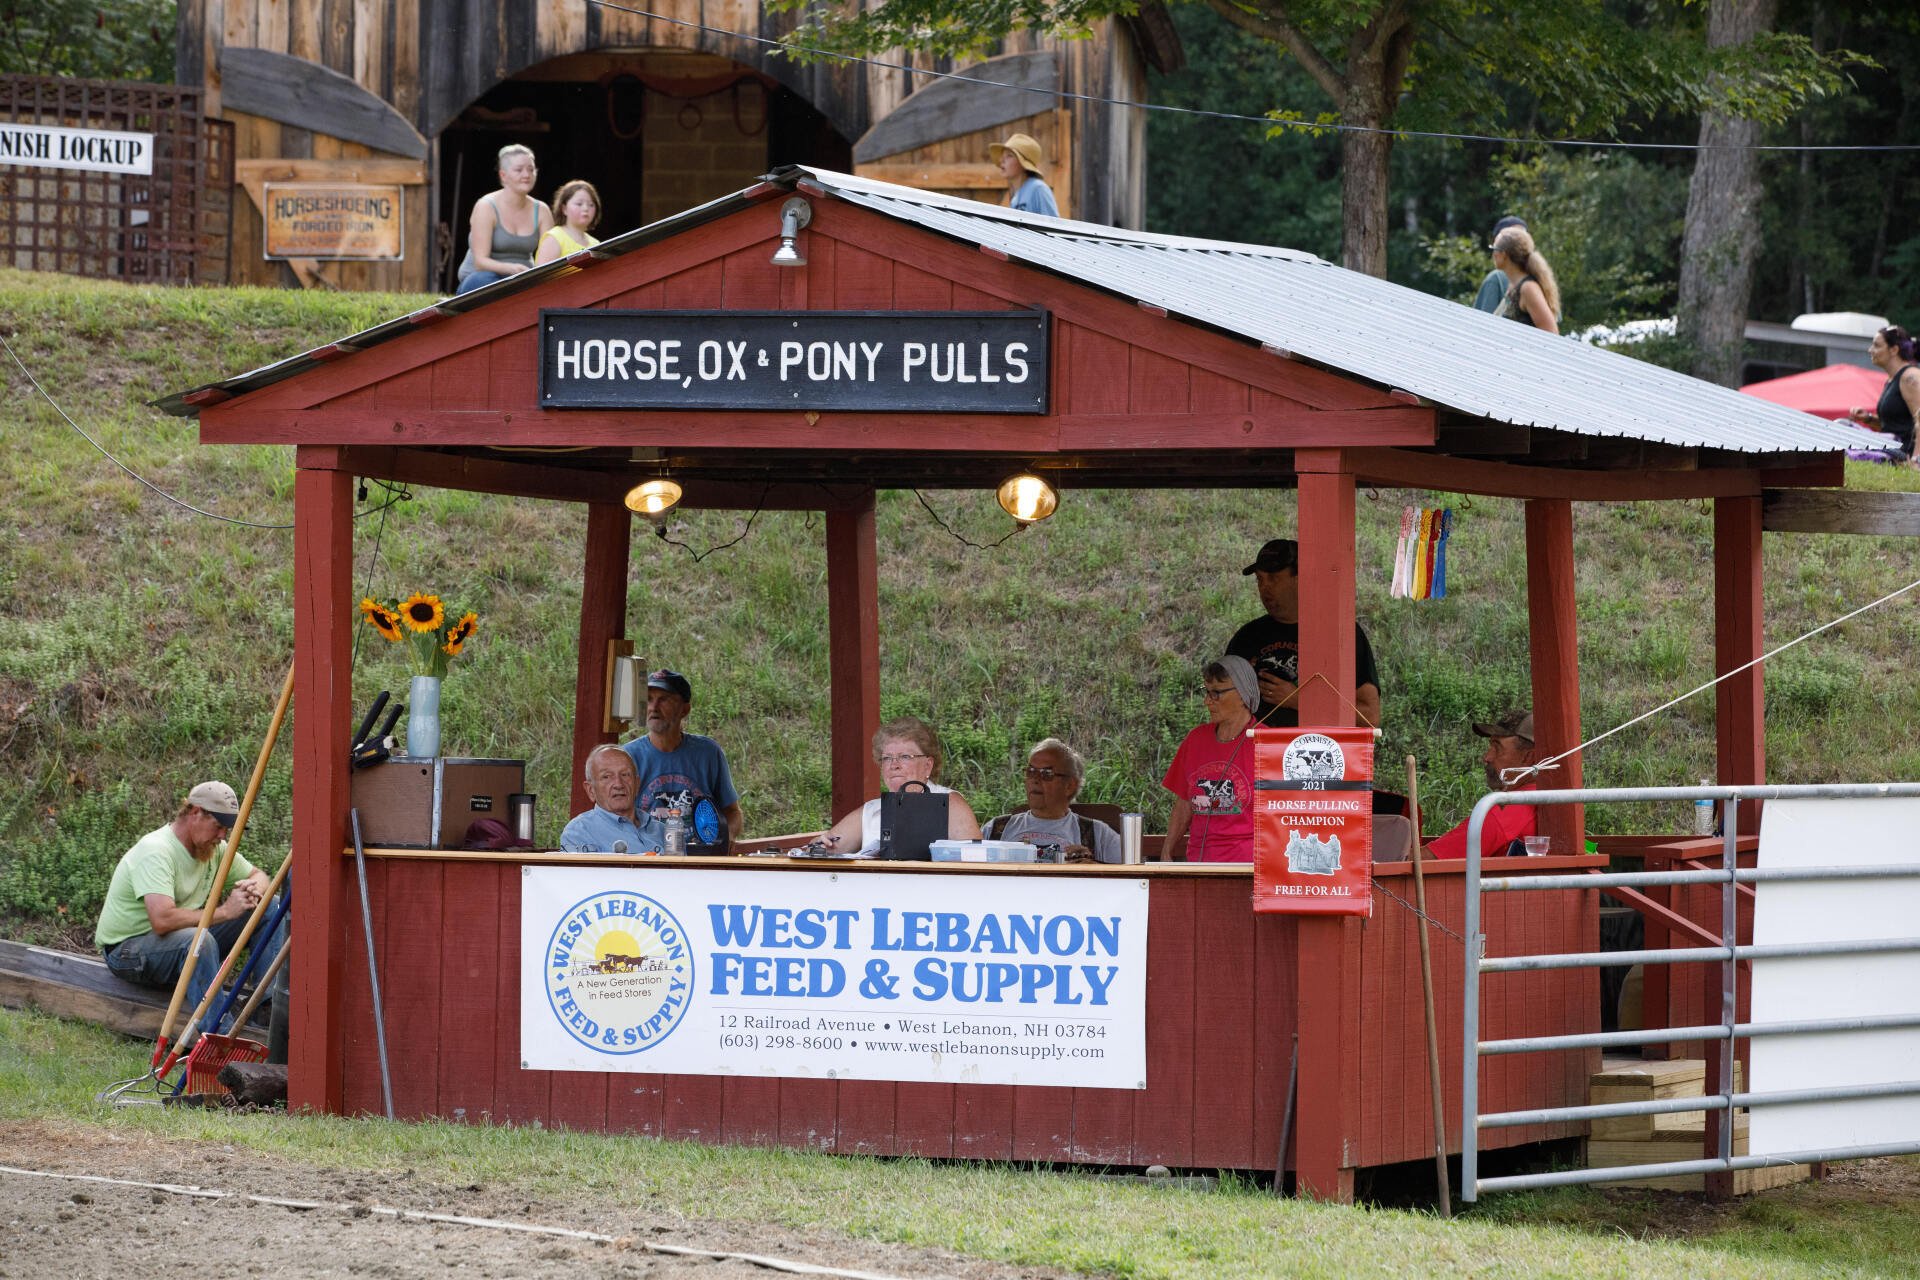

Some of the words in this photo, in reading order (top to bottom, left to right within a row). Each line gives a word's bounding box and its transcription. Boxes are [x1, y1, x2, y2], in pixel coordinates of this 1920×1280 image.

[59, 135, 142, 165] LOCKUP
[275, 196, 391, 220] HORSESHOEING
[293, 220, 343, 233] FORGED
[757, 349, 770, 367] &
[780, 342, 883, 382] PONY
[903, 342, 1029, 384] PULLS
[1293, 735, 1335, 749] CORNISH
[1332, 748, 1344, 770] FAIR
[1301, 781, 1326, 791] 2021
[1267, 800, 1307, 811] HORSE
[1308, 800, 1360, 811] PULLING
[1281, 815, 1345, 826] CHAMPION
[1275, 885, 1303, 896] FREE
[1305, 885, 1329, 896] FOR
[1330, 886, 1352, 896] ALL
[552, 909, 592, 968] WEST
[594, 899, 685, 961] LEBANON
[707, 904, 860, 950] WEST
[871, 908, 1122, 957] LEBANON
[577, 981, 584, 989] A
[586, 980, 606, 988] New
[609, 976, 662, 987] Generation
[710, 952, 847, 999] FEED
[859, 958, 900, 1000] &
[912, 957, 1119, 1006] SUPPLY
[599, 990, 622, 999] Feed
[625, 989, 652, 998] Stores
[555, 986, 599, 1039] FEED
[602, 1027, 619, 1046] &
[623, 975, 687, 1045] SUPPLY
[720, 1015, 737, 1028] 12
[744, 1015, 811, 1031] Railroad
[817, 1018, 876, 1032] Avenue
[898, 1019, 937, 1034] West
[943, 1021, 1018, 1039] Lebanon,
[1024, 1023, 1049, 1037] NH
[1055, 1024, 1107, 1038] 03784
[719, 1034, 759, 1051] (603)
[765, 1035, 843, 1050] 298-8600
[865, 1040, 1105, 1060] www.westlebanonsupply.com
